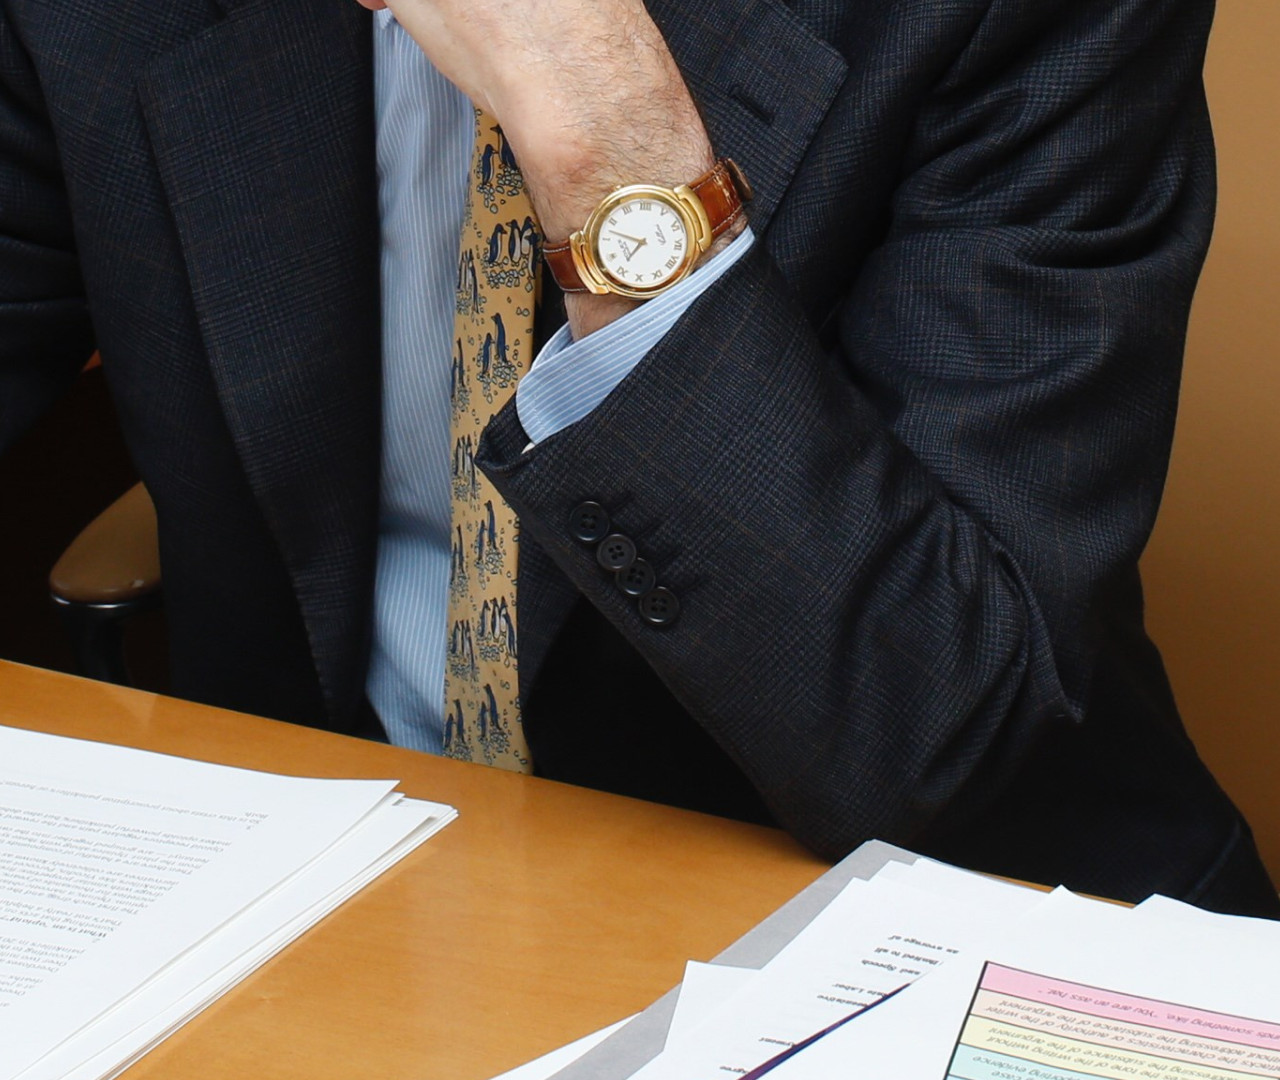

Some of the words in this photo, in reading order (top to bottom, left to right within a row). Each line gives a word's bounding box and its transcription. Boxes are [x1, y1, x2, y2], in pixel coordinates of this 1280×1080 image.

[1070, 994, 1092, 1003] ass
[986, 1006, 1019, 1017] writer
[999, 1000, 1056, 1018] argument
[1021, 1014, 1041, 1023] the
[1057, 1013, 1078, 1023] the
[1080, 1018, 1091, 1026] of
[1059, 1023, 1109, 1038] authority
[1092, 1021, 1153, 1039] substance
[1191, 1018, 1252, 1035] something
[988, 1027, 1045, 1045] argument
[1157, 1034, 1176, 1043] the
[986, 1036, 1030, 1051] without
[1048, 1040, 1067, 1049] the
[1127, 1038, 1215, 1059] characteristics
[1178, 1039, 1245, 1056] addressing
[1032, 1046, 1071, 1060] writing
[1084, 1048, 1146, 1066] substance
[973, 1055, 1026, 1073] evidence
[1074, 1056, 1094, 1066] the
[1148, 1062, 1168, 1071] the
[1217, 1056, 1237, 1064] the
[1111, 1063, 1139, 1075] tone
